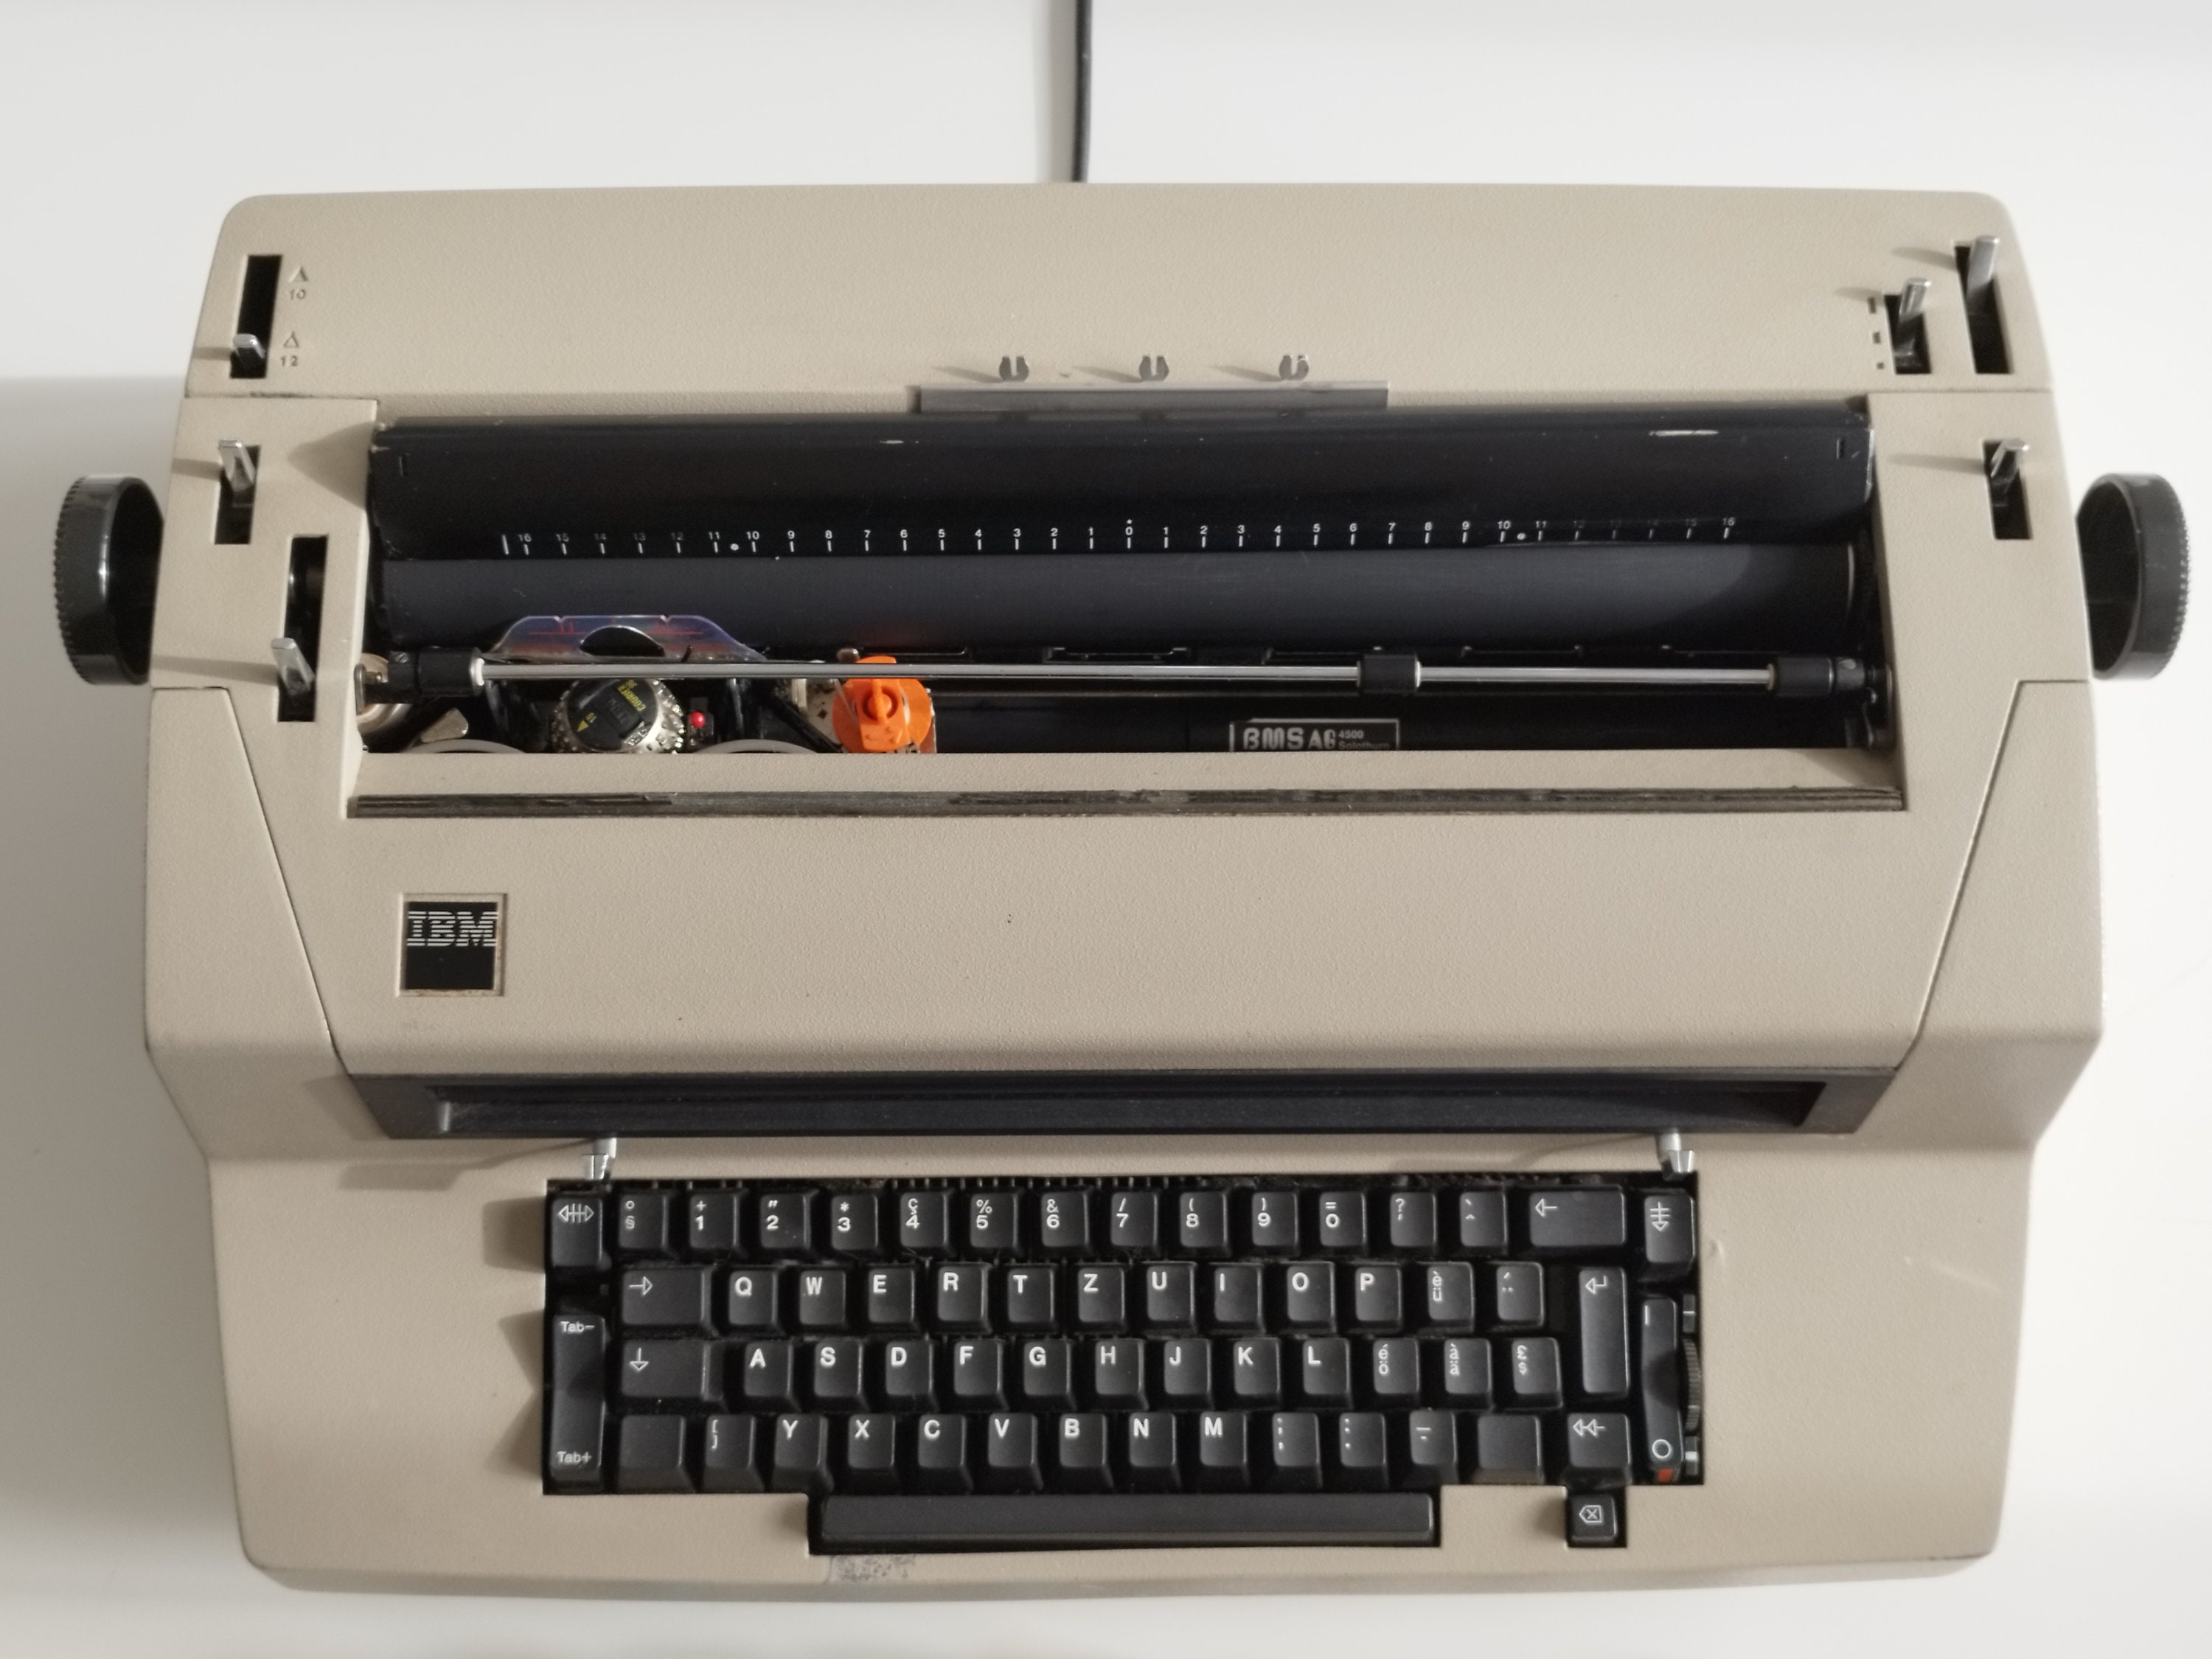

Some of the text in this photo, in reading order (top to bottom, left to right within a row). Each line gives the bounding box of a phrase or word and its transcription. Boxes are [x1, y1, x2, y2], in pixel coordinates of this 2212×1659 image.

[289, 288, 306, 300] 10
[281, 355, 299, 367] 12
[518, 533, 532, 543] 16
[556, 533, 569, 542] 15
[709, 532, 720, 540] 11
[746, 531, 760, 540] 10
[787, 530, 795, 540] 9
[825, 529, 832, 540] 8
[863, 529, 871, 538] 7
[900, 529, 908, 538] 6
[938, 529, 945, 538] 5
[975, 529, 982, 538] 4
[1013, 528, 1021, 538] 3
[1051, 527, 1058, 537] 2
[1088, 526, 1093, 536] 1
[1125, 526, 1133, 536] 0
[1164, 526, 1169, 535] 1
[1200, 525, 1208, 535] 2
[1237, 524, 1245, 534] 3
[1274, 525, 1281, 534] 4
[1312, 523, 1321, 533] 5
[1349, 523, 1357, 532] 6
[1388, 522, 1397, 532] 7
[1424, 521, 1433, 532] 8
[1461, 521, 1470, 530] 9
[1498, 520, 1511, 530] 10
[1723, 517, 1735, 526] 16
[617, 684, 646, 712] COURIER
[1243, 727, 1336, 751] BMS AG
[1338, 729, 1364, 739] 4500
[407, 911, 499, 947] IBM
[695, 1215, 704, 1231] 1
[766, 1214, 779, 1231] 2
[837, 1217, 851, 1232] 3
[905, 1214, 920, 1229] 4
[975, 1214, 989, 1230] 5
[1046, 1214, 1060, 1229] 6
[1116, 1212, 1129, 1228] 7
[1186, 1213, 1199, 1228] 8
[1257, 1212, 1271, 1227] 9
[734, 1276, 752, 1296] Q
[805, 1276, 823, 1295] W
[872, 1274, 887, 1294] E
[942, 1272, 959, 1292] R
[1012, 1274, 1028, 1294] T
[1083, 1273, 1099, 1293] Z
[1152, 1271, 1167, 1290] U
[1219, 1273, 1225, 1292] I
[1291, 1272, 1309, 1292] O
[1360, 1273, 1374, 1292] P
[1431, 1270, 1443, 1287] è
[1433, 1285, 1443, 1302] ü
[749, 1348, 766, 1368] A
[819, 1346, 836, 1367] S
[891, 1346, 907, 1367] D
[959, 1345, 974, 1366] F
[1029, 1346, 1046, 1366] G
[1100, 1345, 1116, 1365] H
[1169, 1346, 1181, 1366] J
[1238, 1346, 1253, 1366] K
[1307, 1346, 1321, 1366] L
[1377, 1343, 1388, 1362] é
[1449, 1343, 1460, 1362] à
[1516, 1345, 1527, 1360] £
[1378, 1360, 1389, 1376] ö
[782, 1419, 799, 1439] Y
[855, 1419, 870, 1439] X
[923, 1419, 940, 1439] C
[994, 1418, 1009, 1439] V
[1064, 1418, 1080, 1439] B
[1133, 1418, 1149, 1438] N
[1204, 1416, 1222, 1436] M
[556, 1450, 591, 1464] Tab+
